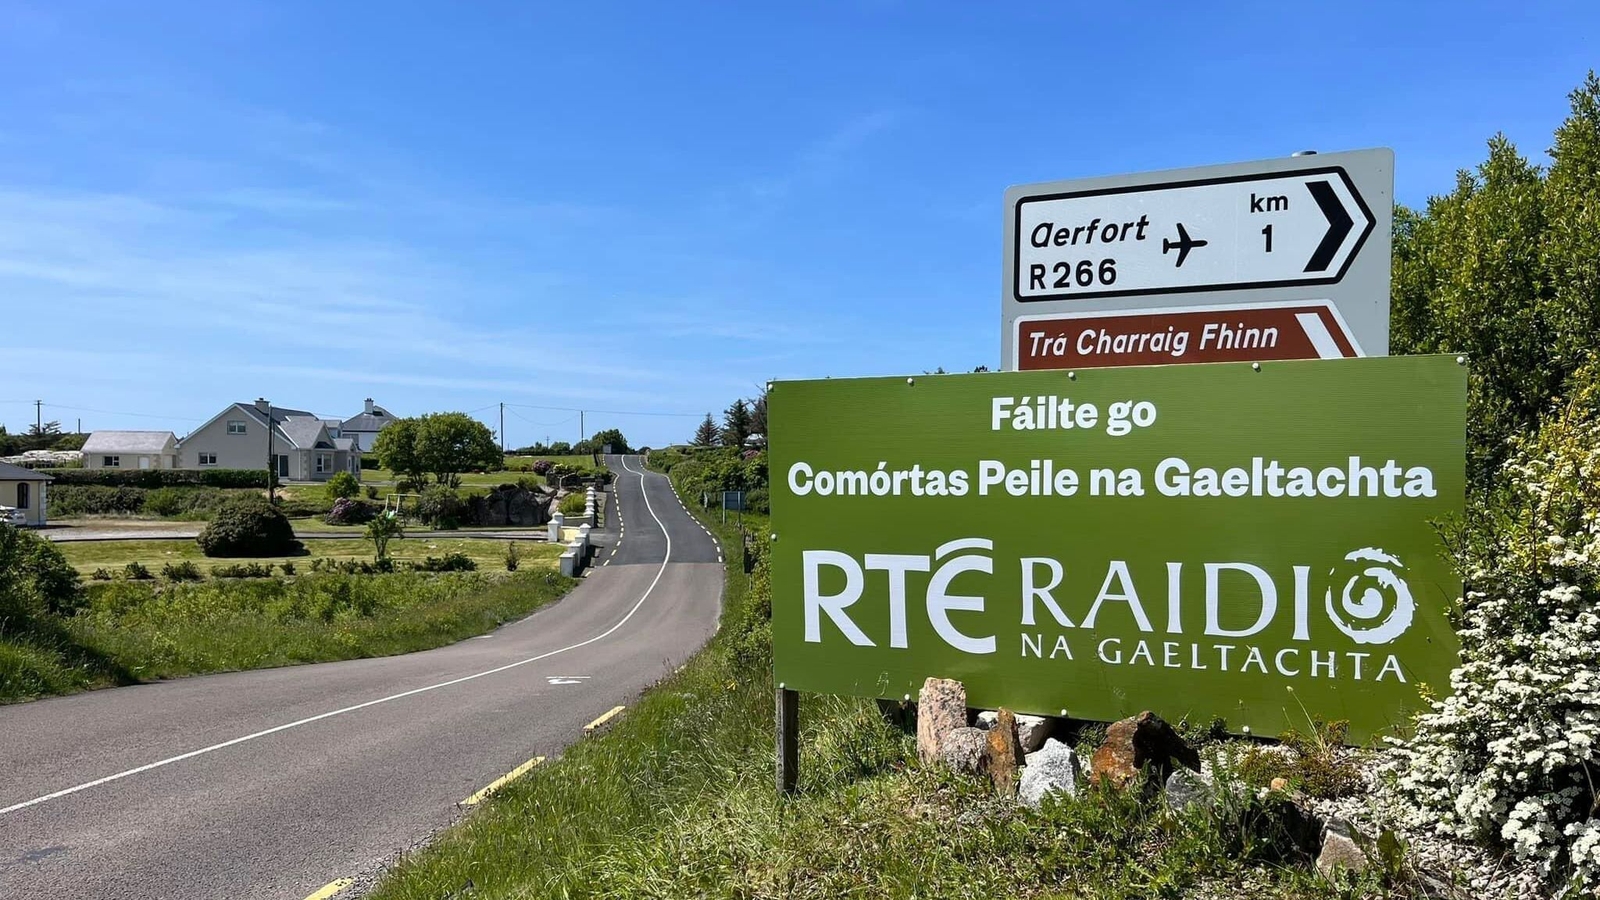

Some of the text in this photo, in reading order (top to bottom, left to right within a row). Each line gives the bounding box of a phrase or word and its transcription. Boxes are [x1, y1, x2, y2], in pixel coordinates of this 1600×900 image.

[1250, 193, 1289, 213] km
[1261, 224, 1273, 253] 1
[1029, 258, 1118, 291] R266
[1029, 322, 1278, 357] Trá Charraig Fhinn
[991, 395, 1157, 437] Fáilte go
[787, 455, 1438, 498] Comórtas Peile na Gaeltachta
[802, 537, 997, 654] RTÉ
[1021, 632, 1407, 684] NA GAELTACHTA
